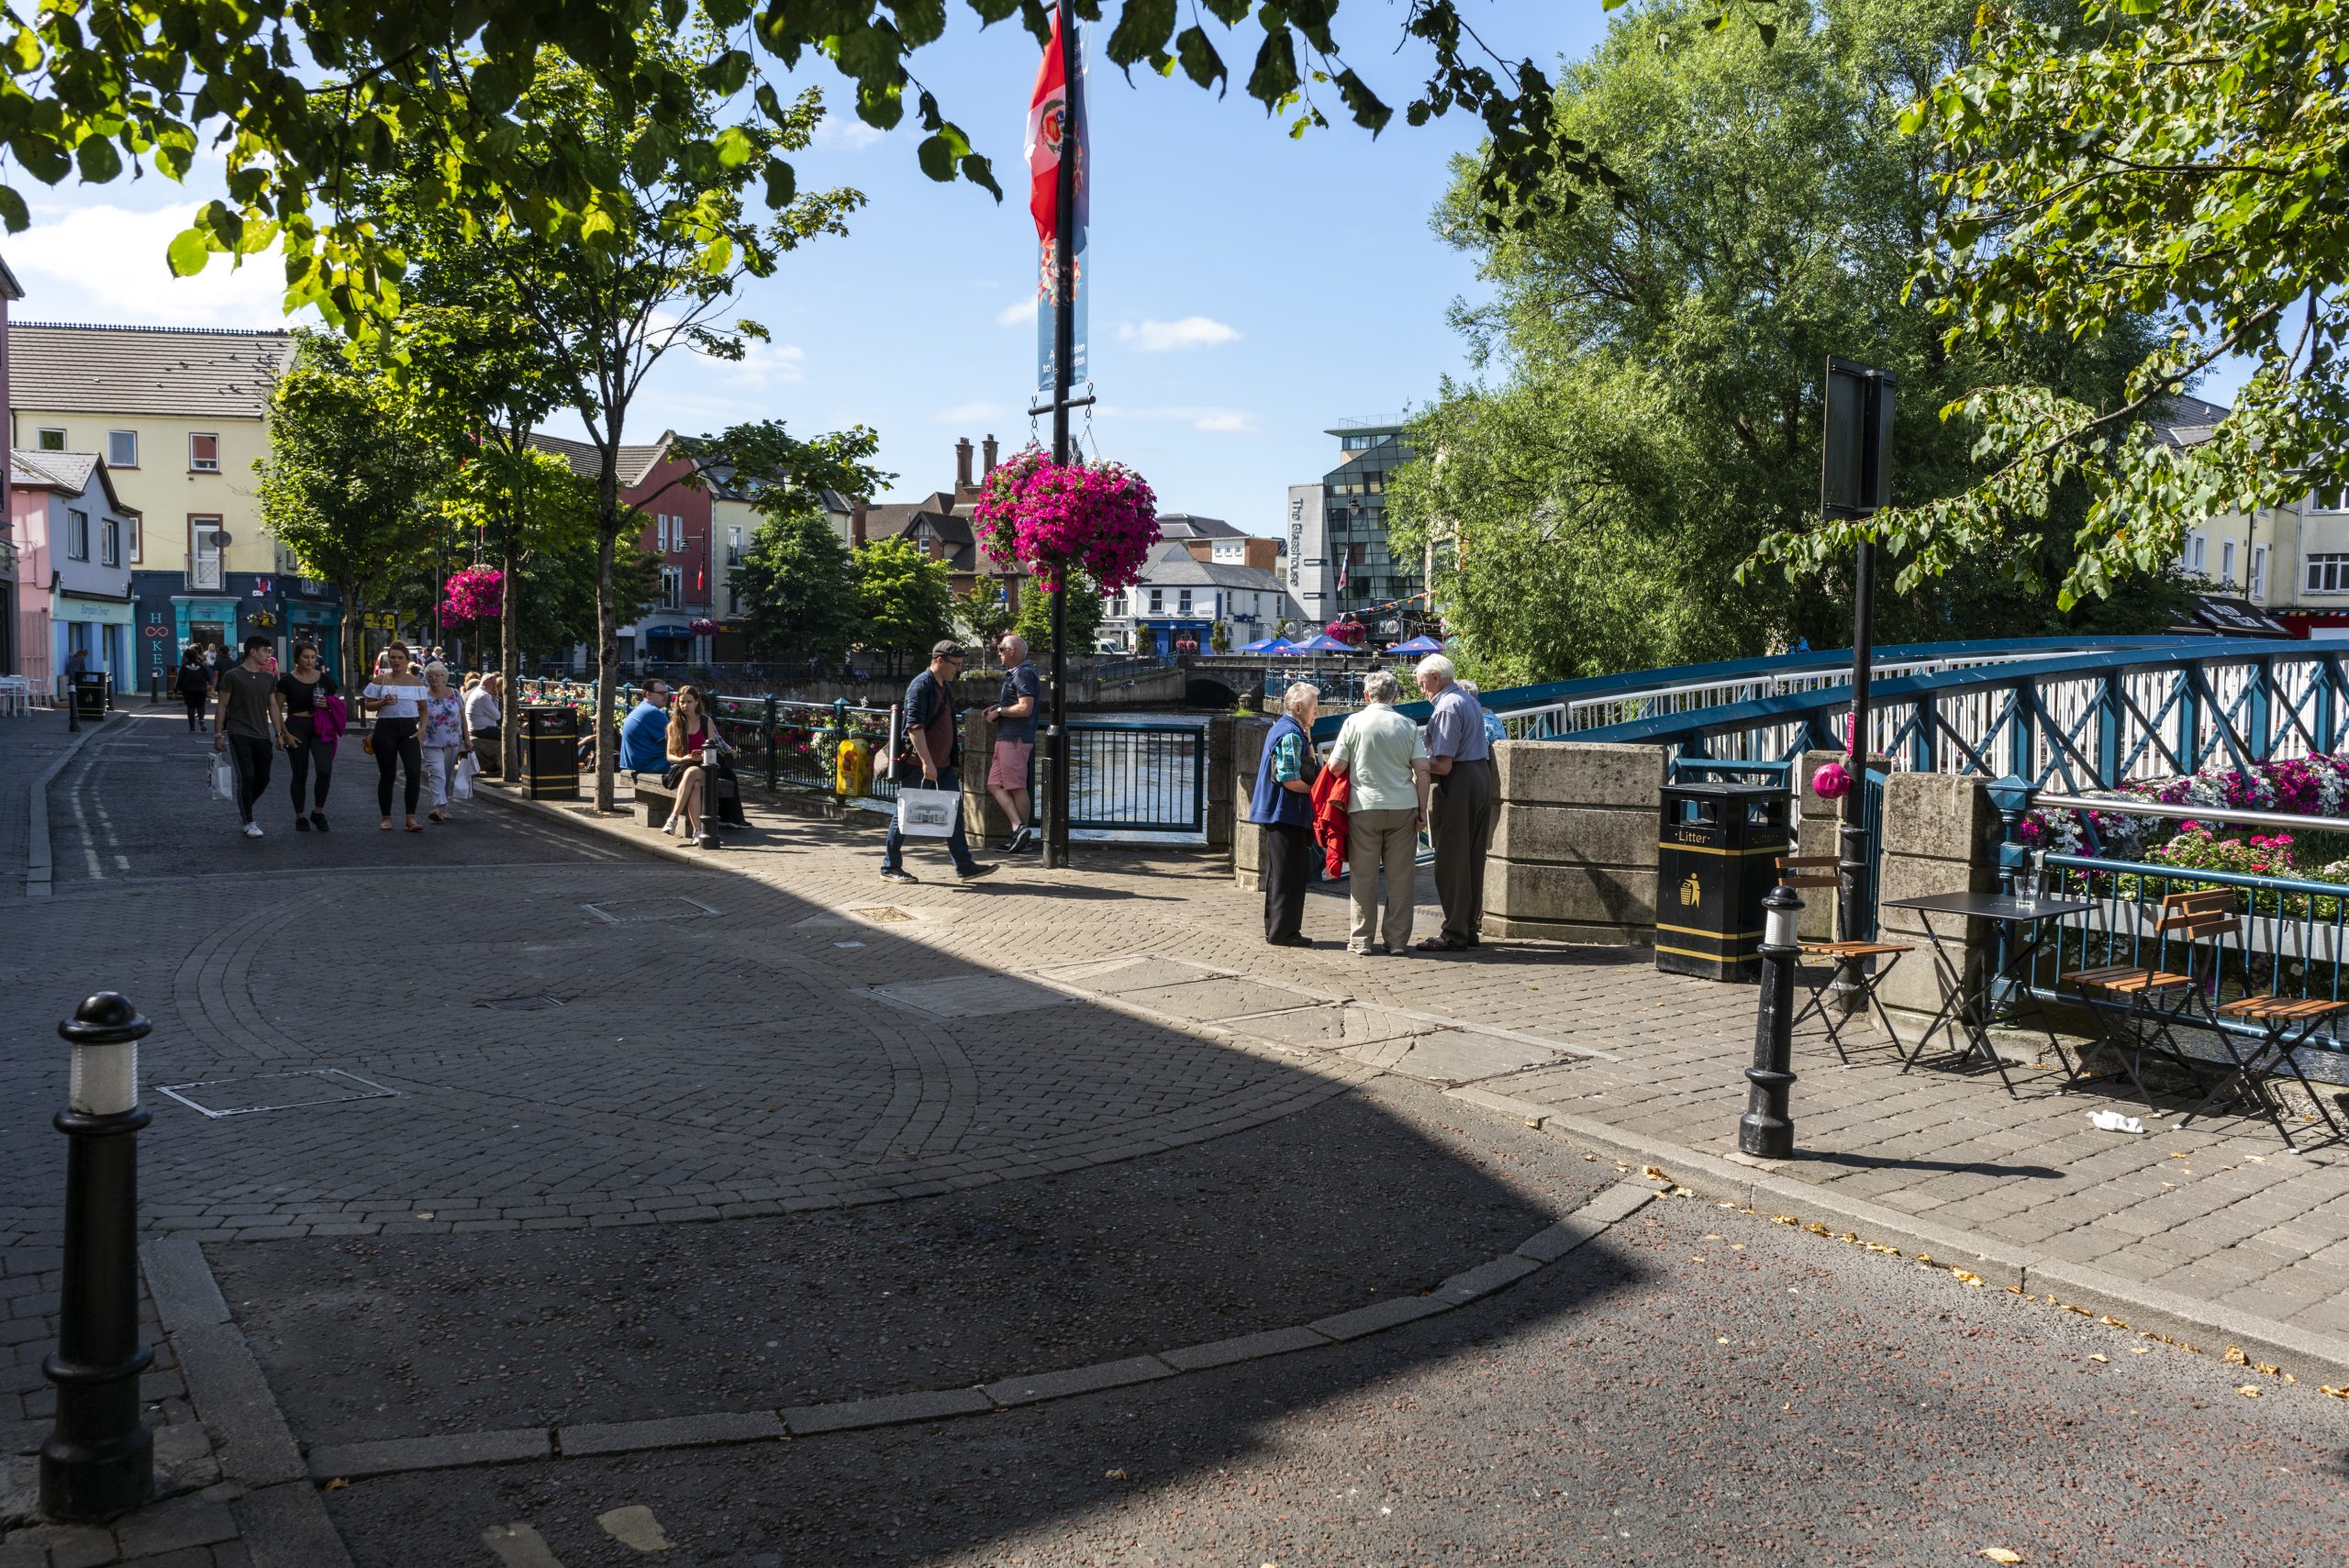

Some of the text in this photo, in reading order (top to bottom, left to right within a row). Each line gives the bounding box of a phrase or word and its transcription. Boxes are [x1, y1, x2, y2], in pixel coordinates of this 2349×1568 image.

[1290, 498, 1304, 587] The Glasshouse
[1678, 829, 1708, 844] Litter
